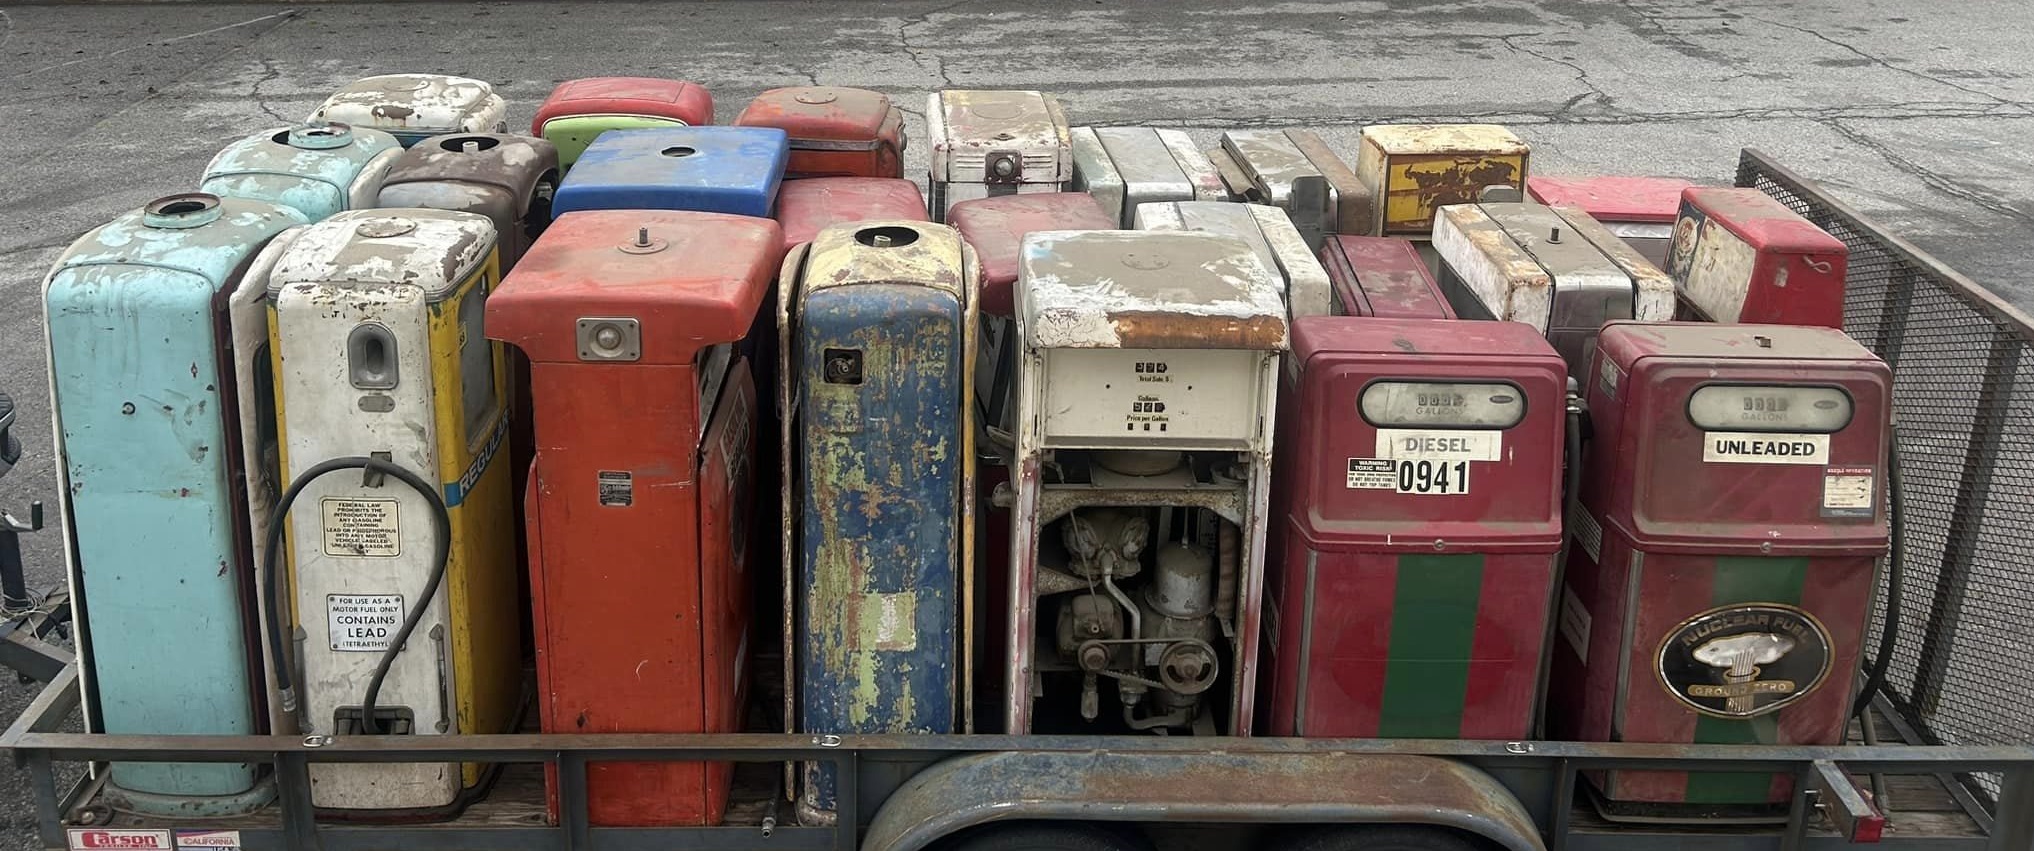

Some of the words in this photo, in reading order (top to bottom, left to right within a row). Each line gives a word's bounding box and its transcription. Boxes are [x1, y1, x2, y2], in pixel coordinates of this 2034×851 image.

[1415, 407, 1465, 415] GALLONS
[1741, 412, 1788, 421] GALLONS
[1405, 437, 1471, 453] DIESEL
[1716, 439, 1815, 456] UNLEADED
[1400, 460, 1466, 493] 0941
[337, 615, 396, 625] CONTAINS
[347, 627, 387, 638] LEAD
[1681, 614, 1769, 646] NUCLEAR
[1773, 617, 1809, 644] FUEL
[1695, 685, 1748, 697] GROUND
[1755, 683, 1787, 693] ZERO
[82, 832, 157, 847] Carson
[183, 836, 235, 845] CALIFORNIA
